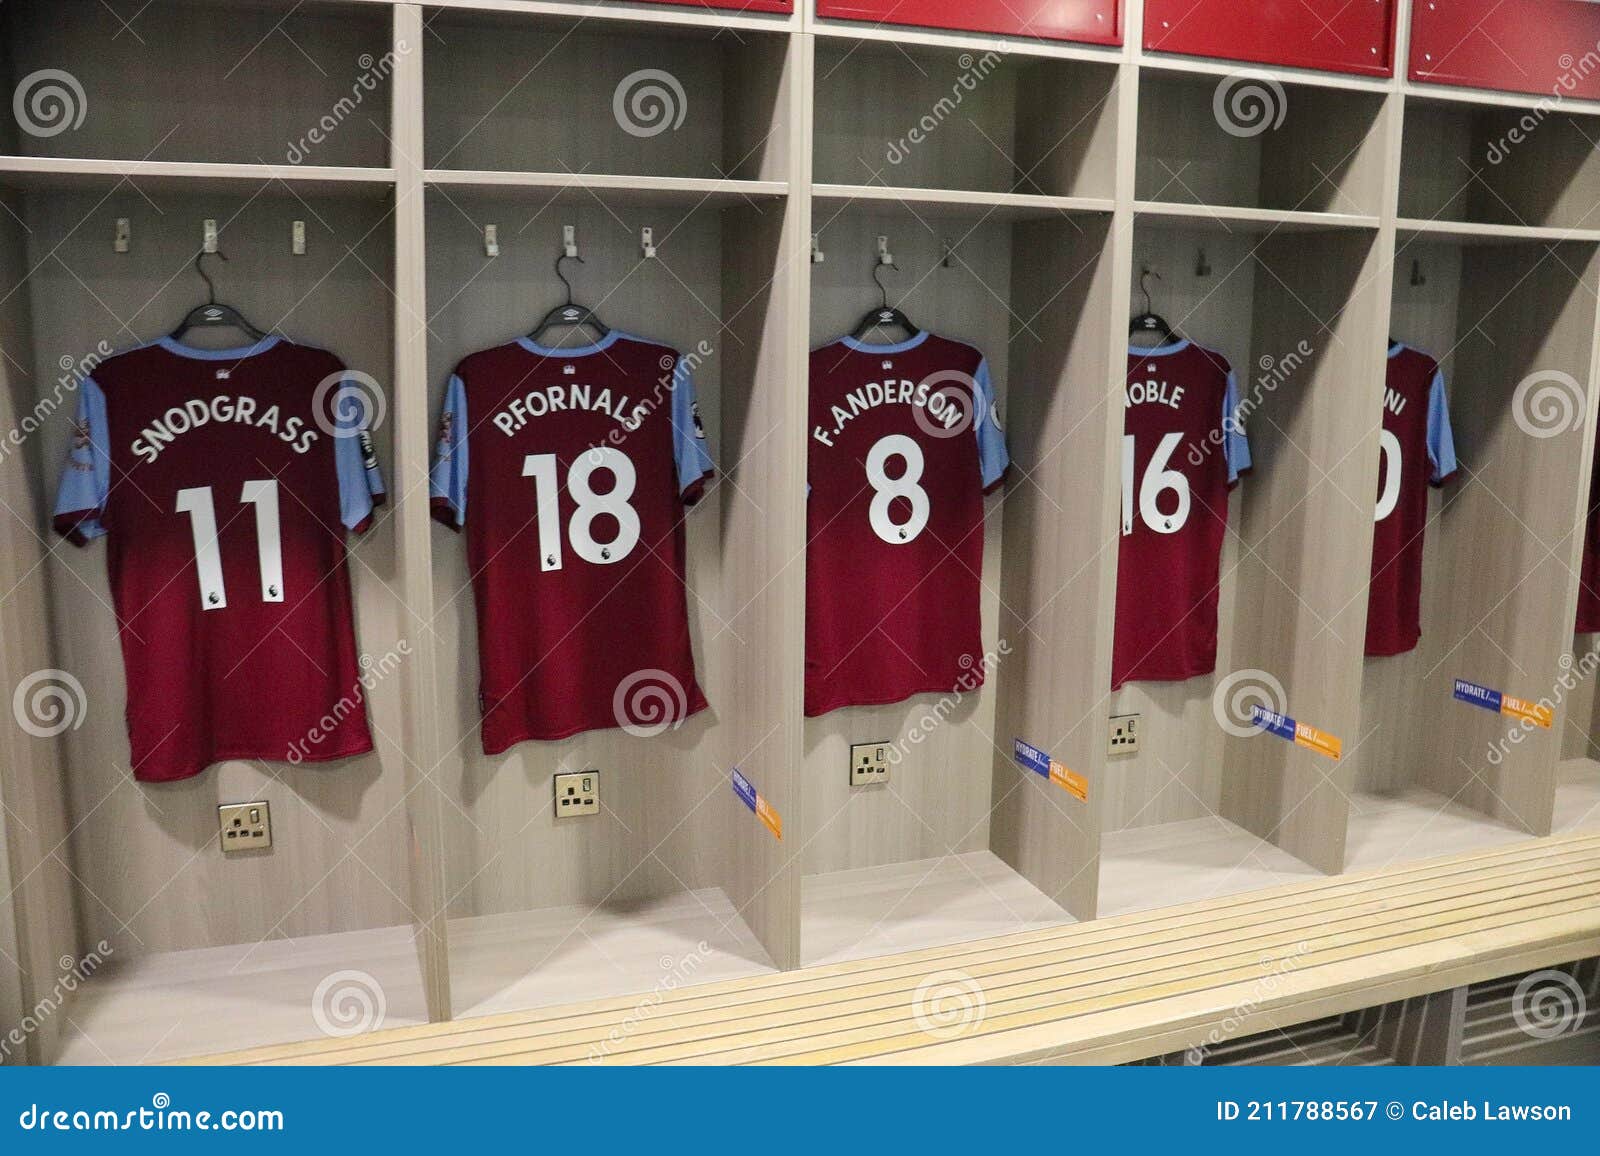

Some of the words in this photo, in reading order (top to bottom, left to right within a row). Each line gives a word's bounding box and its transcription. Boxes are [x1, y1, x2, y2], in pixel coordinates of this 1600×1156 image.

[131, 395, 319, 464] SNODGRASS
[492, 384, 648, 437] P.FORNALS
[813, 379, 963, 447] F.ANDERSON
[521, 447, 640, 572] 18
[866, 434, 930, 545] 8
[175, 480, 284, 611] 11
